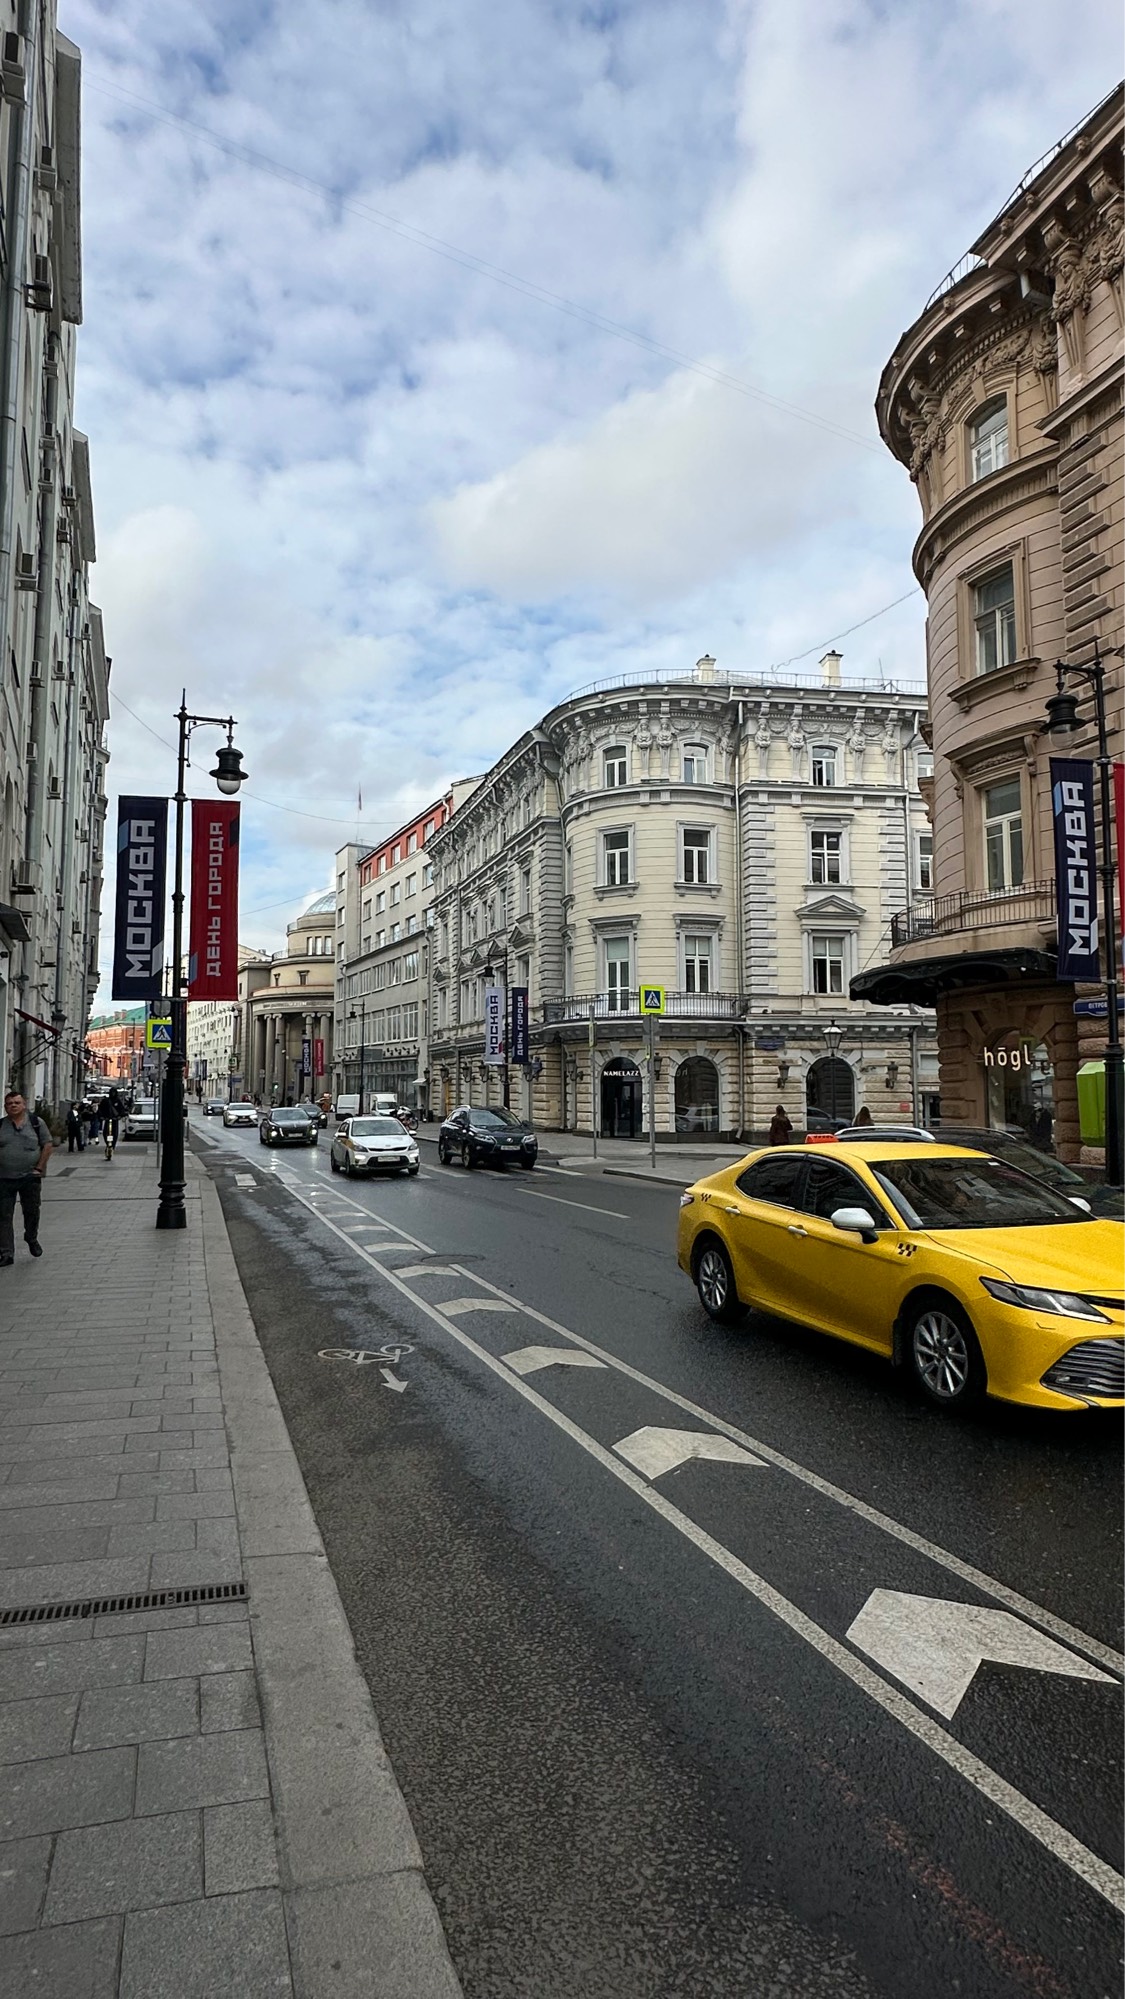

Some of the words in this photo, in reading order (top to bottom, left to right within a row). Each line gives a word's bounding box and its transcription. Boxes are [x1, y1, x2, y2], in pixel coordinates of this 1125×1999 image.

[125, 819, 156, 978] МОСКВА
[208, 822, 223, 910] ГОРОДА
[1061, 780, 1093, 956] МОСКВА
[206, 916, 222, 977] ДЕНЬ
[489, 995, 499, 1055] МОСКВА
